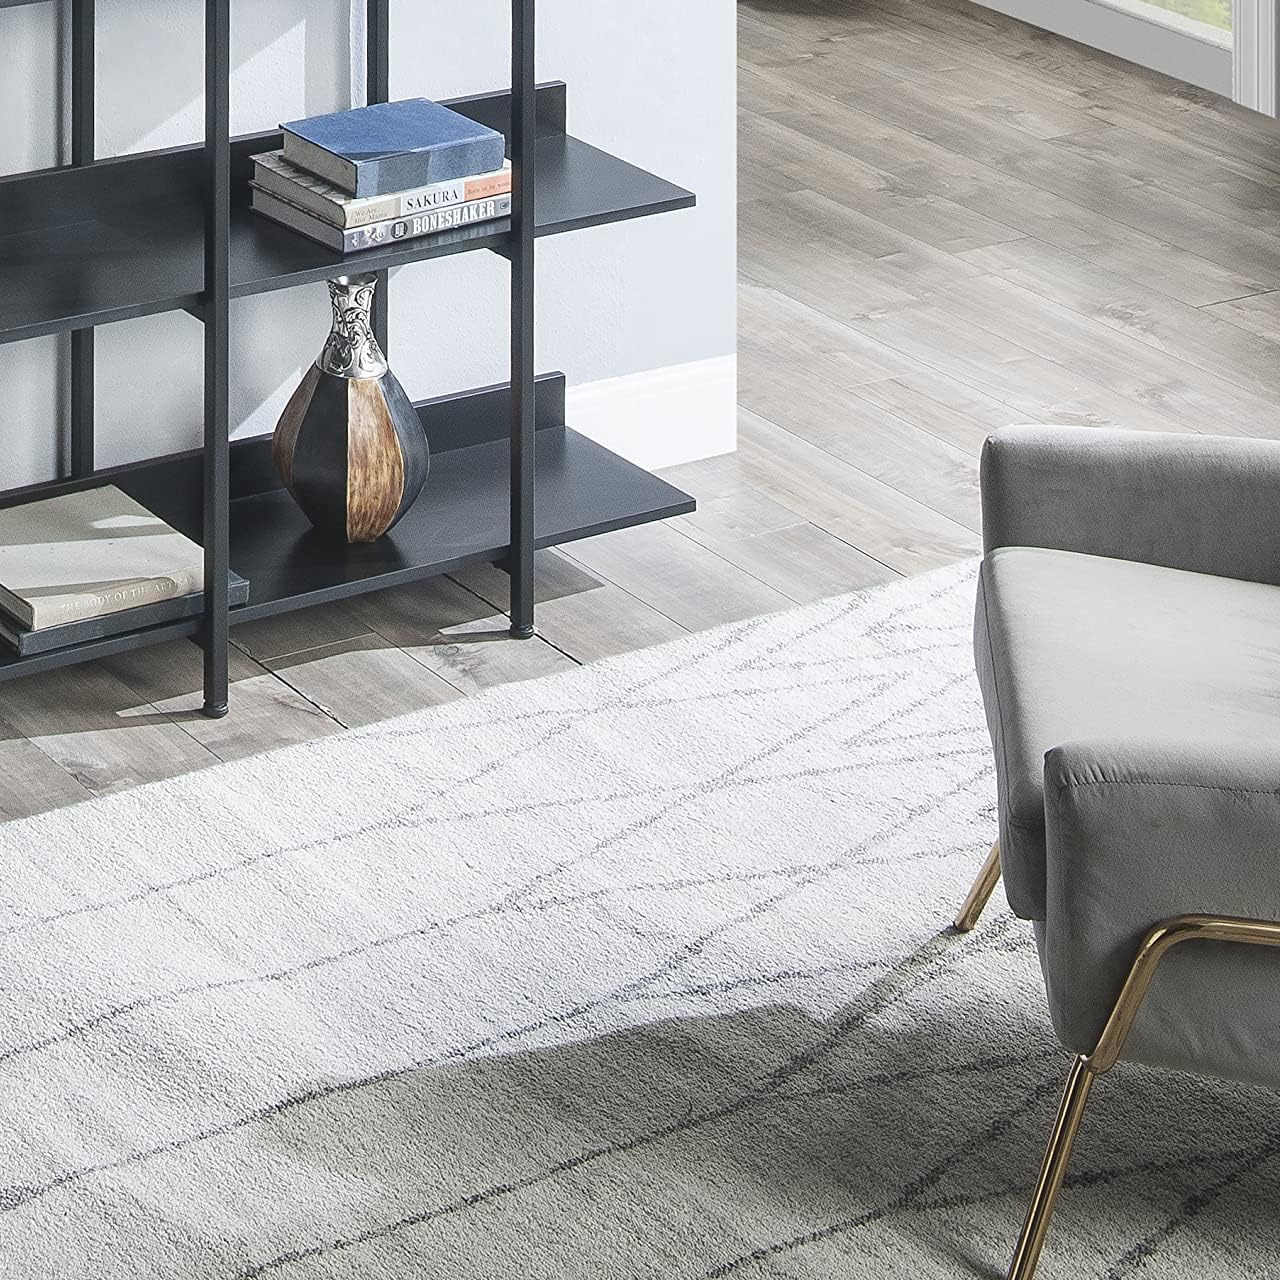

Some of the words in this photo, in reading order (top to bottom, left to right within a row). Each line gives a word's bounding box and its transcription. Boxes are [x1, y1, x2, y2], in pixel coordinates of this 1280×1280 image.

[406, 188, 458, 211] SAKURA
[412, 200, 496, 235] BONESHAKER
[114, 591, 127, 601] OF
